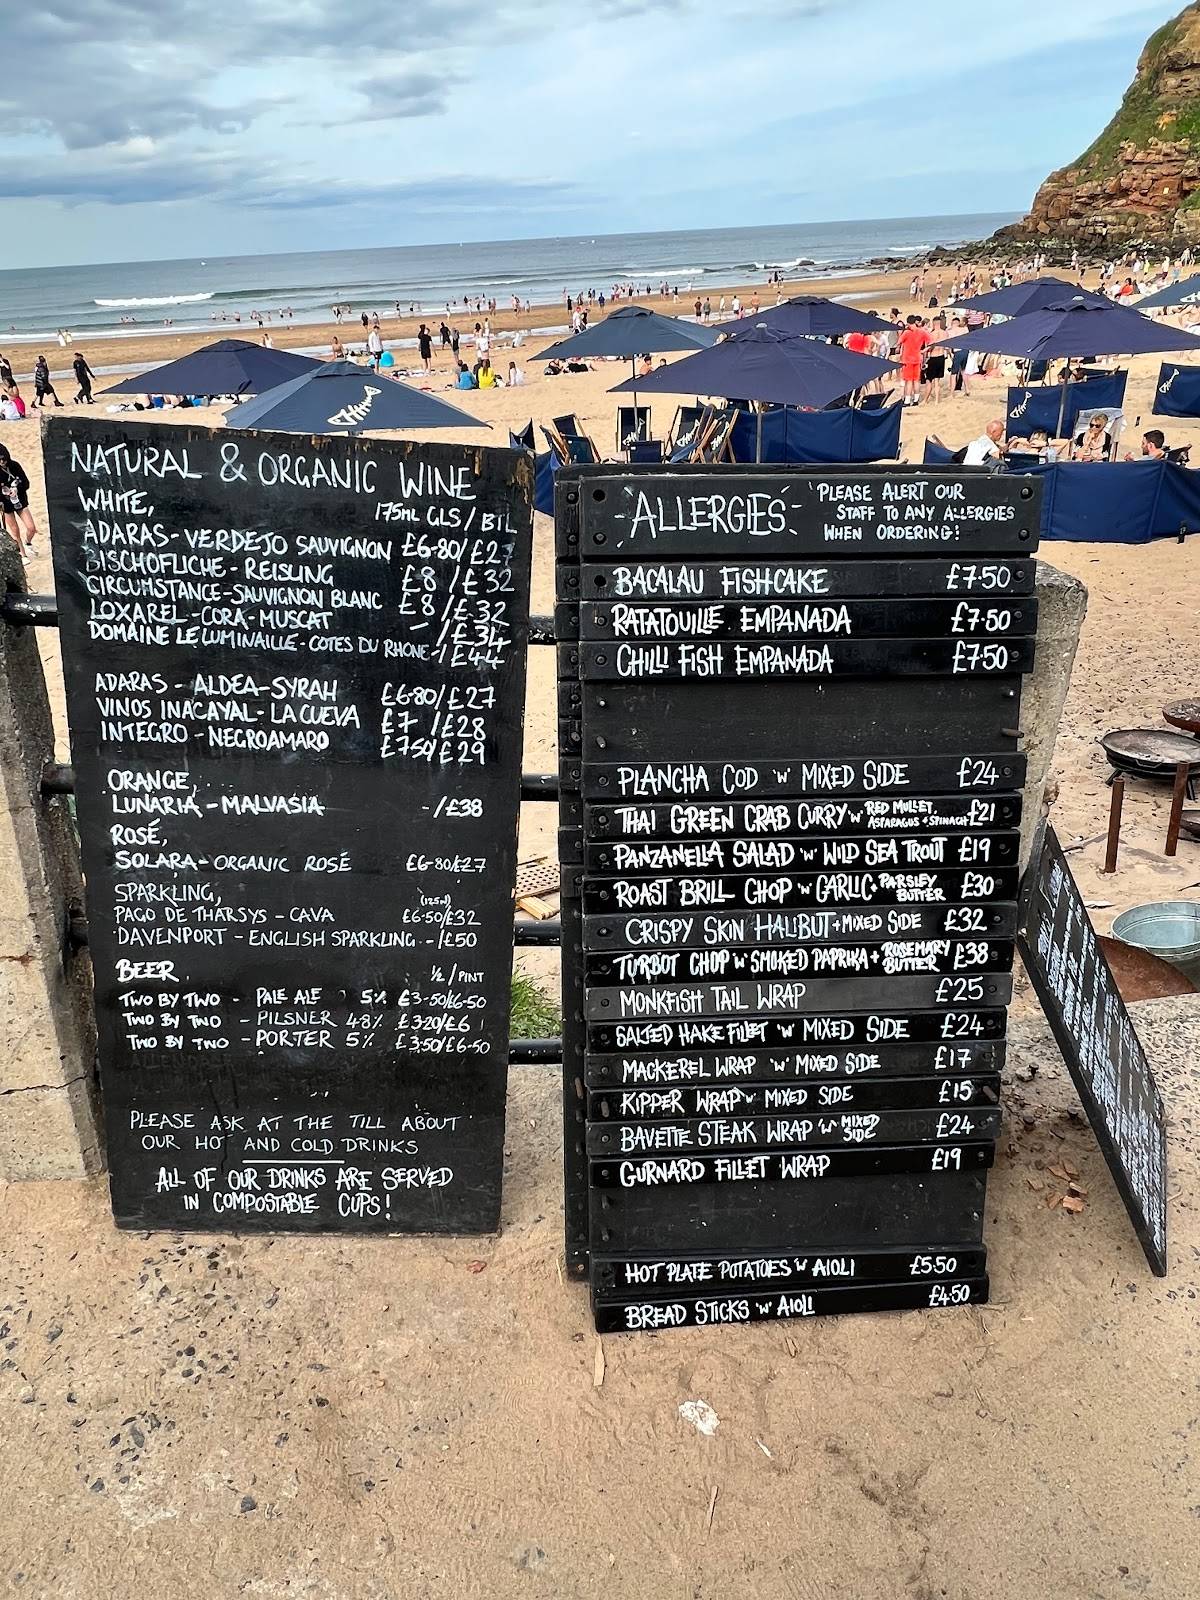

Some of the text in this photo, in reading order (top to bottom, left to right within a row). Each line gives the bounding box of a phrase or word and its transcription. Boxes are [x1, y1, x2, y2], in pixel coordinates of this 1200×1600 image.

[71, 441, 477, 500] NATURAL & ORGANIC WINE
[77, 486, 154, 517] WHITE,
[817, 481, 966, 502] PLEASE ALERT OUR
[836, 504, 1016, 522] STAFF TO ANY ALLERGIES
[824, 524, 863, 541] WHEN
[295, 535, 393, 562] SAUVIGNON
[244, 556, 334, 586] REISLING
[612, 565, 830, 597] BACALAU FISHCAKE
[331, 590, 383, 610] BLANC
[610, 603, 852, 637] RATATOUILLE EMPANADA
[87, 620, 379, 654] DOMAINE LE DU
[616, 643, 834, 677] CHILLI FISH EMPANADA
[95, 671, 168, 694] ADARAS
[96, 697, 152, 719] VINOS
[101, 721, 330, 752] INTEGRO NEGROAMARO
[617, 757, 1000, 796] PLANCHA COD MIXED SIDE £24
[614, 807, 656, 835] THAI
[670, 804, 735, 835] GREEN
[744, 804, 791, 833] CRAB
[797, 802, 848, 830] CURRY
[864, 800, 890, 816] RED
[867, 816, 920, 830] ASPARAGUS
[967, 799, 996, 827] £21
[304, 851, 352, 874] ROSÉ
[612, 836, 992, 870] PANZANELLA SALAD WILD SEA TROUT £19
[612, 878, 673, 908] ROAST
[679, 878, 736, 906] BRILL
[744, 877, 793, 905] CHOP
[961, 871, 995, 899] £30
[896, 888, 947, 901] BUTTER
[113, 905, 336, 924] PAGO DE THARSYS CAVA
[625, 907, 988, 945] CRISPY SKIN HALIBUT SIDE £32
[117, 926, 416, 948] DAVENPORT ENGLISH SPARKLING
[612, 952, 681, 981] TURBOT
[689, 949, 731, 976] CHOP
[750, 949, 809, 975] SMOKED
[811, 948, 869, 971] PAPRIKA
[953, 942, 989, 971] £38
[881, 956, 941, 975] BUTTER
[118, 987, 323, 1008] TWO BY TWO PALE ALE
[619, 976, 984, 1017] MONKFISH TAIL WRAP £25
[122, 1009, 338, 1029] TWO BY TWO PILSNER
[616, 1013, 985, 1048] SALTED HAKE FILLET MIXED SIDE £24
[126, 1034, 158, 1051] TWO
[164, 1035, 184, 1050] BY
[191, 1037, 230, 1051] TWO
[256, 1029, 335, 1049] PORTER
[622, 1045, 972, 1084] MACKEREL WRAP MIXED SIDE £17
[619, 1080, 973, 1116] KIPPER WRAP MIXED SIDE £15
[130, 1110, 462, 1132] PLEASE ASK AT THE TILL ABOUT
[619, 1112, 975, 1153] BAVETTE STEAK WRAP MIXED £24
[842, 1127, 877, 1143] SIDE
[141, 1134, 419, 1155] OUR AND COLD DRINKS
[155, 1166, 454, 1192] ALL OF OUR DRINKS ARE SERVED
[619, 1147, 962, 1188] GURNARD FILLET WRAP £19
[184, 1191, 392, 1220] IN COMPOSTABLE CUPS!
[625, 1257, 855, 1284] HOT PLATE POTATOES AIOLI
[624, 1294, 815, 1329] BREAD STICKS AIOLI
